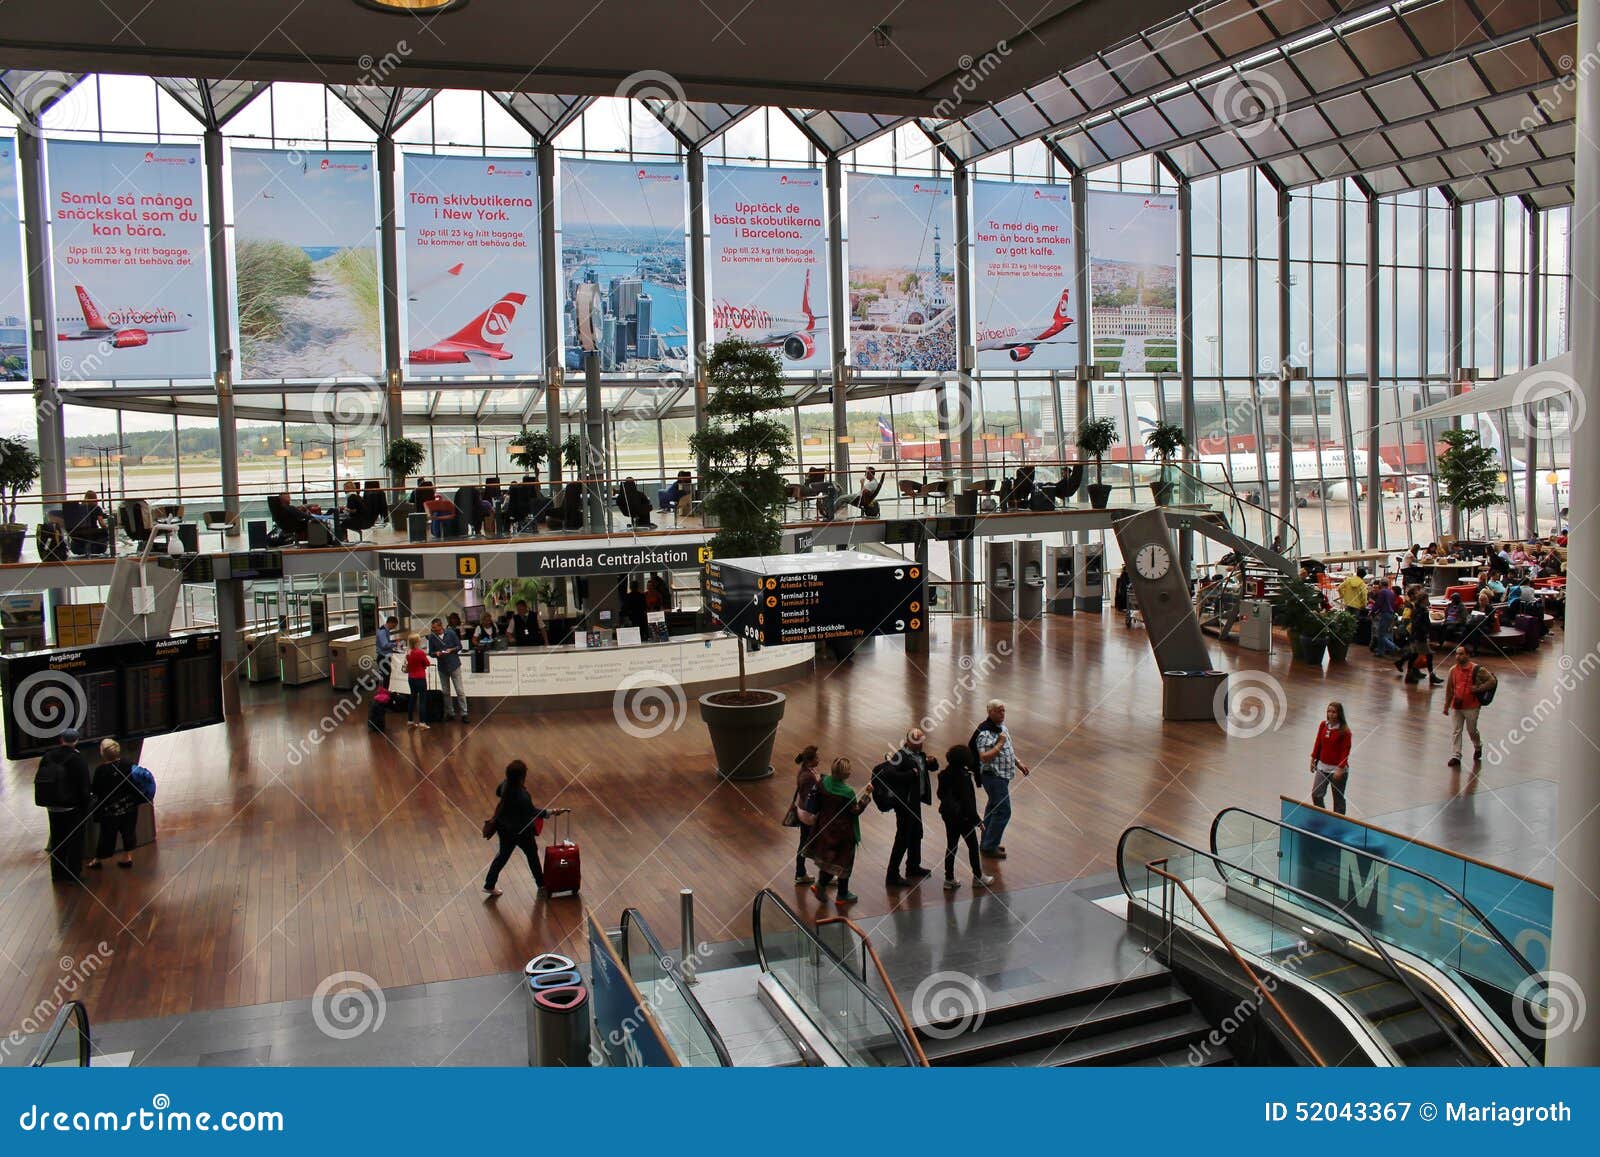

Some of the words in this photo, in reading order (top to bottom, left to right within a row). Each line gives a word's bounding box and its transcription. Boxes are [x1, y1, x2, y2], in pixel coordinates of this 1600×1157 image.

[61, 191, 111, 205] Samla
[117, 193, 135, 205] så
[140, 193, 192, 209] många
[410, 192, 438, 204] Töm
[444, 194, 532, 206] skivbutikerna
[57, 207, 137, 220] snäckskal
[142, 211, 173, 221] som
[179, 209, 197, 221] du
[735, 202, 781, 214] Upptäck
[786, 203, 800, 213] de
[443, 209, 472, 219] New
[477, 209, 509, 221] York.
[714, 214, 746, 224] bästa
[750, 215, 821, 226] skobutikerna
[93, 223, 121, 236] kan
[127, 224, 166, 237] bära.
[742, 228, 802, 238] Barcelona.
[989, 221, 999, 230] Ta
[1002, 222, 1022, 230] med
[1025, 223, 1038, 233] dig
[419, 229, 435, 237] Upp
[464, 230, 473, 238] kg
[977, 233, 996, 241] hem
[1000, 234, 1011, 242] än
[1014, 234, 1034, 243] bara
[1037, 235, 1070, 244] smaken
[120, 247, 131, 256] kg
[152, 248, 190, 256] bagage.
[724, 247, 737, 256] Upp
[1010, 247, 1027, 256] gott
[1030, 247, 1054, 256] kaffe.
[108, 308, 176, 325] airberlin
[383, 558, 416, 571] Tickets
[540, 554, 593, 568] Arlanda
[598, 550, 688, 566] Centralstation
